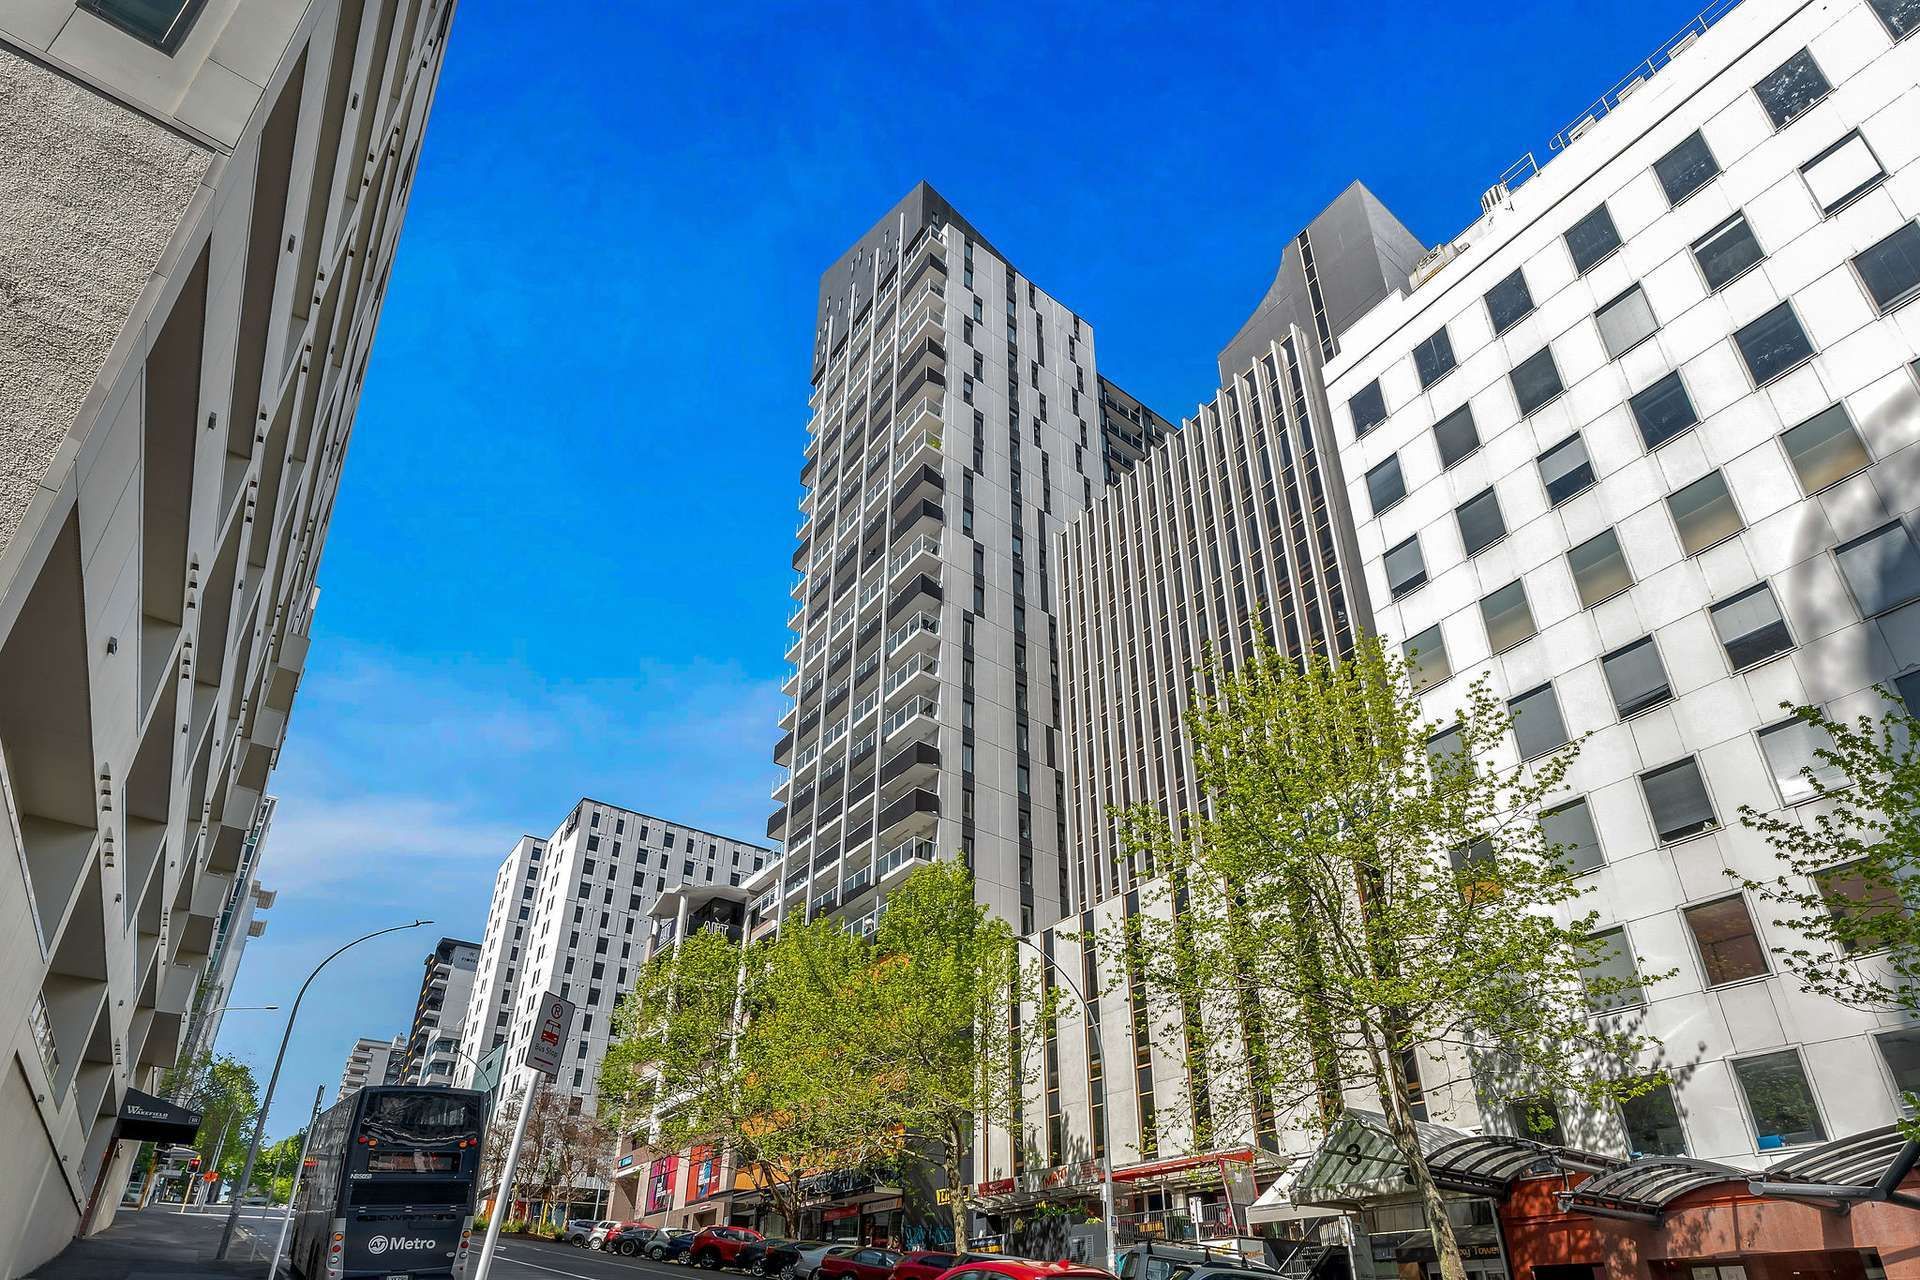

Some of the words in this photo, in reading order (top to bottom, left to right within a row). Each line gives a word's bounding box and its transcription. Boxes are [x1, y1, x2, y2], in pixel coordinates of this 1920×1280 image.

[535, 1042, 545, 1053] Bus
[1345, 1143, 1363, 1166] 3
[389, 1237, 436, 1250] Metro
